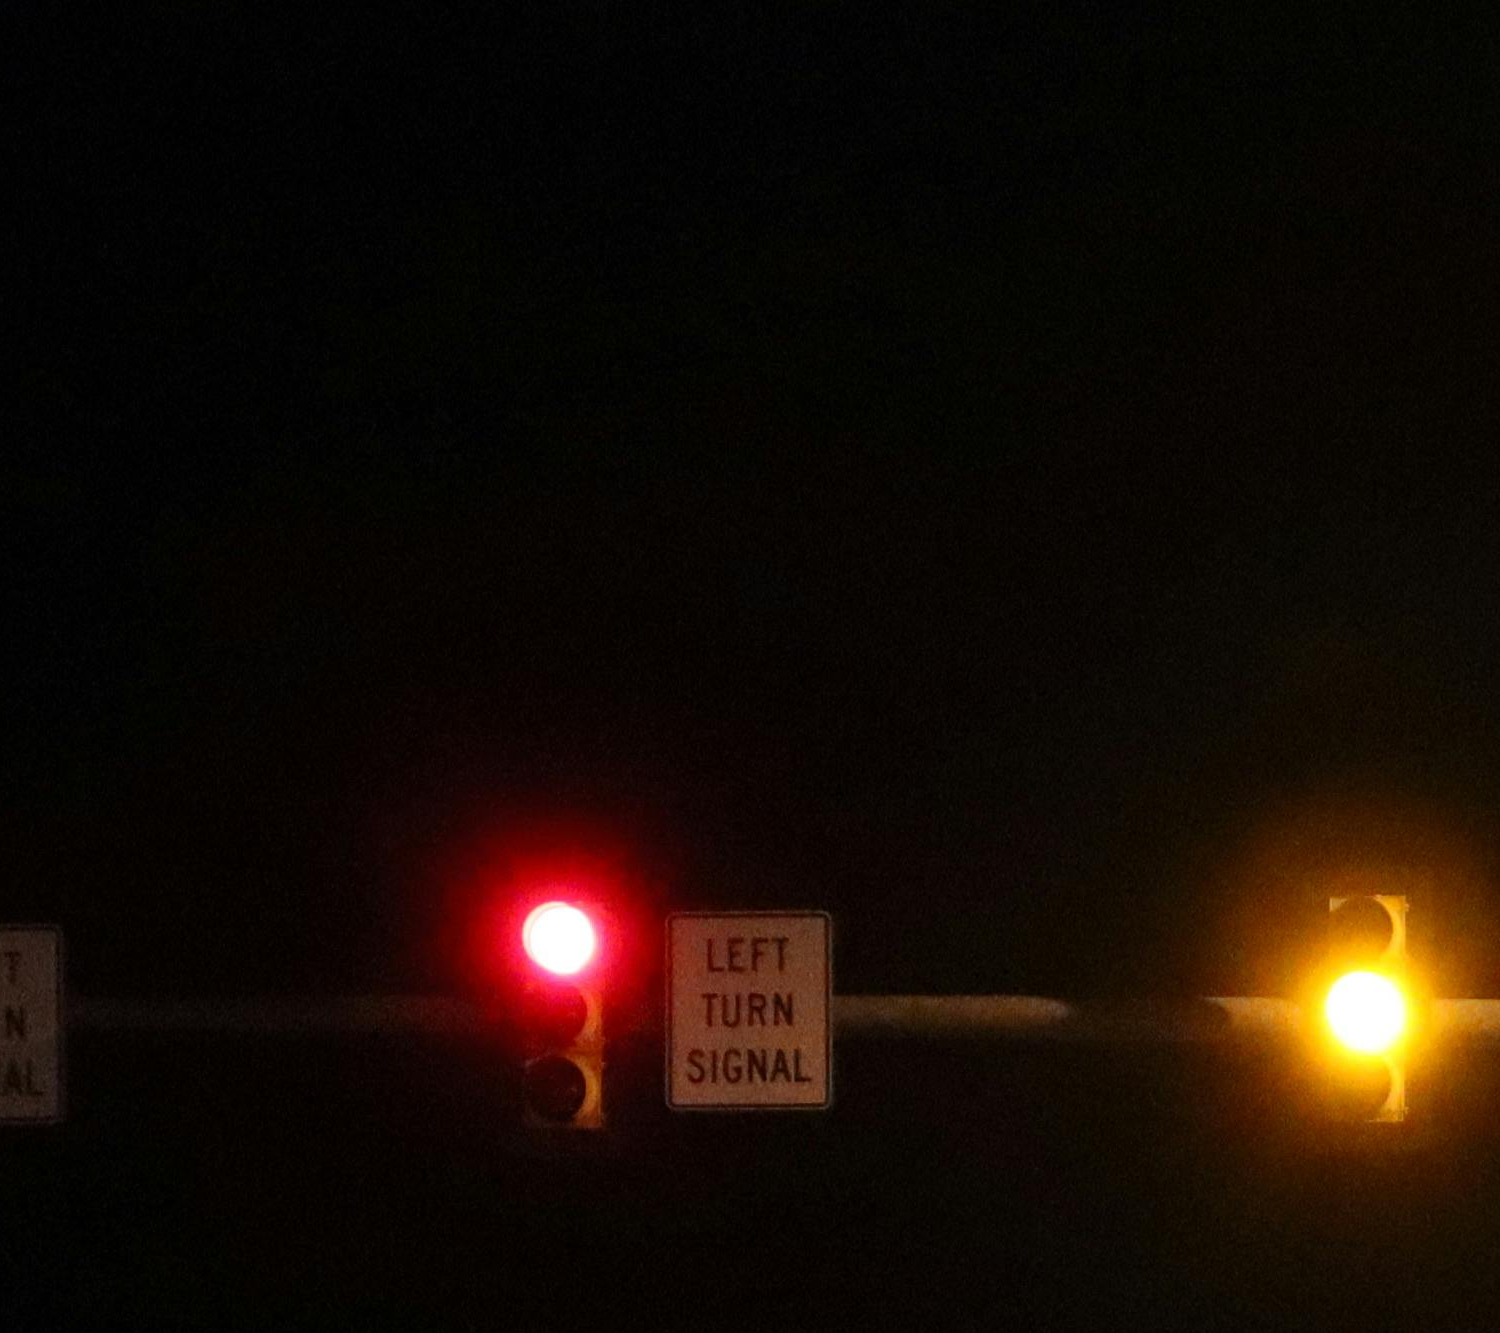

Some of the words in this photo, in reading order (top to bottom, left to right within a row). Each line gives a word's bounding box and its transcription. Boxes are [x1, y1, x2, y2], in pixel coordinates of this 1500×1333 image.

[706, 936, 788, 973] LEFT
[701, 992, 794, 1029] TURN
[686, 1049, 811, 1086] SIGNAL
